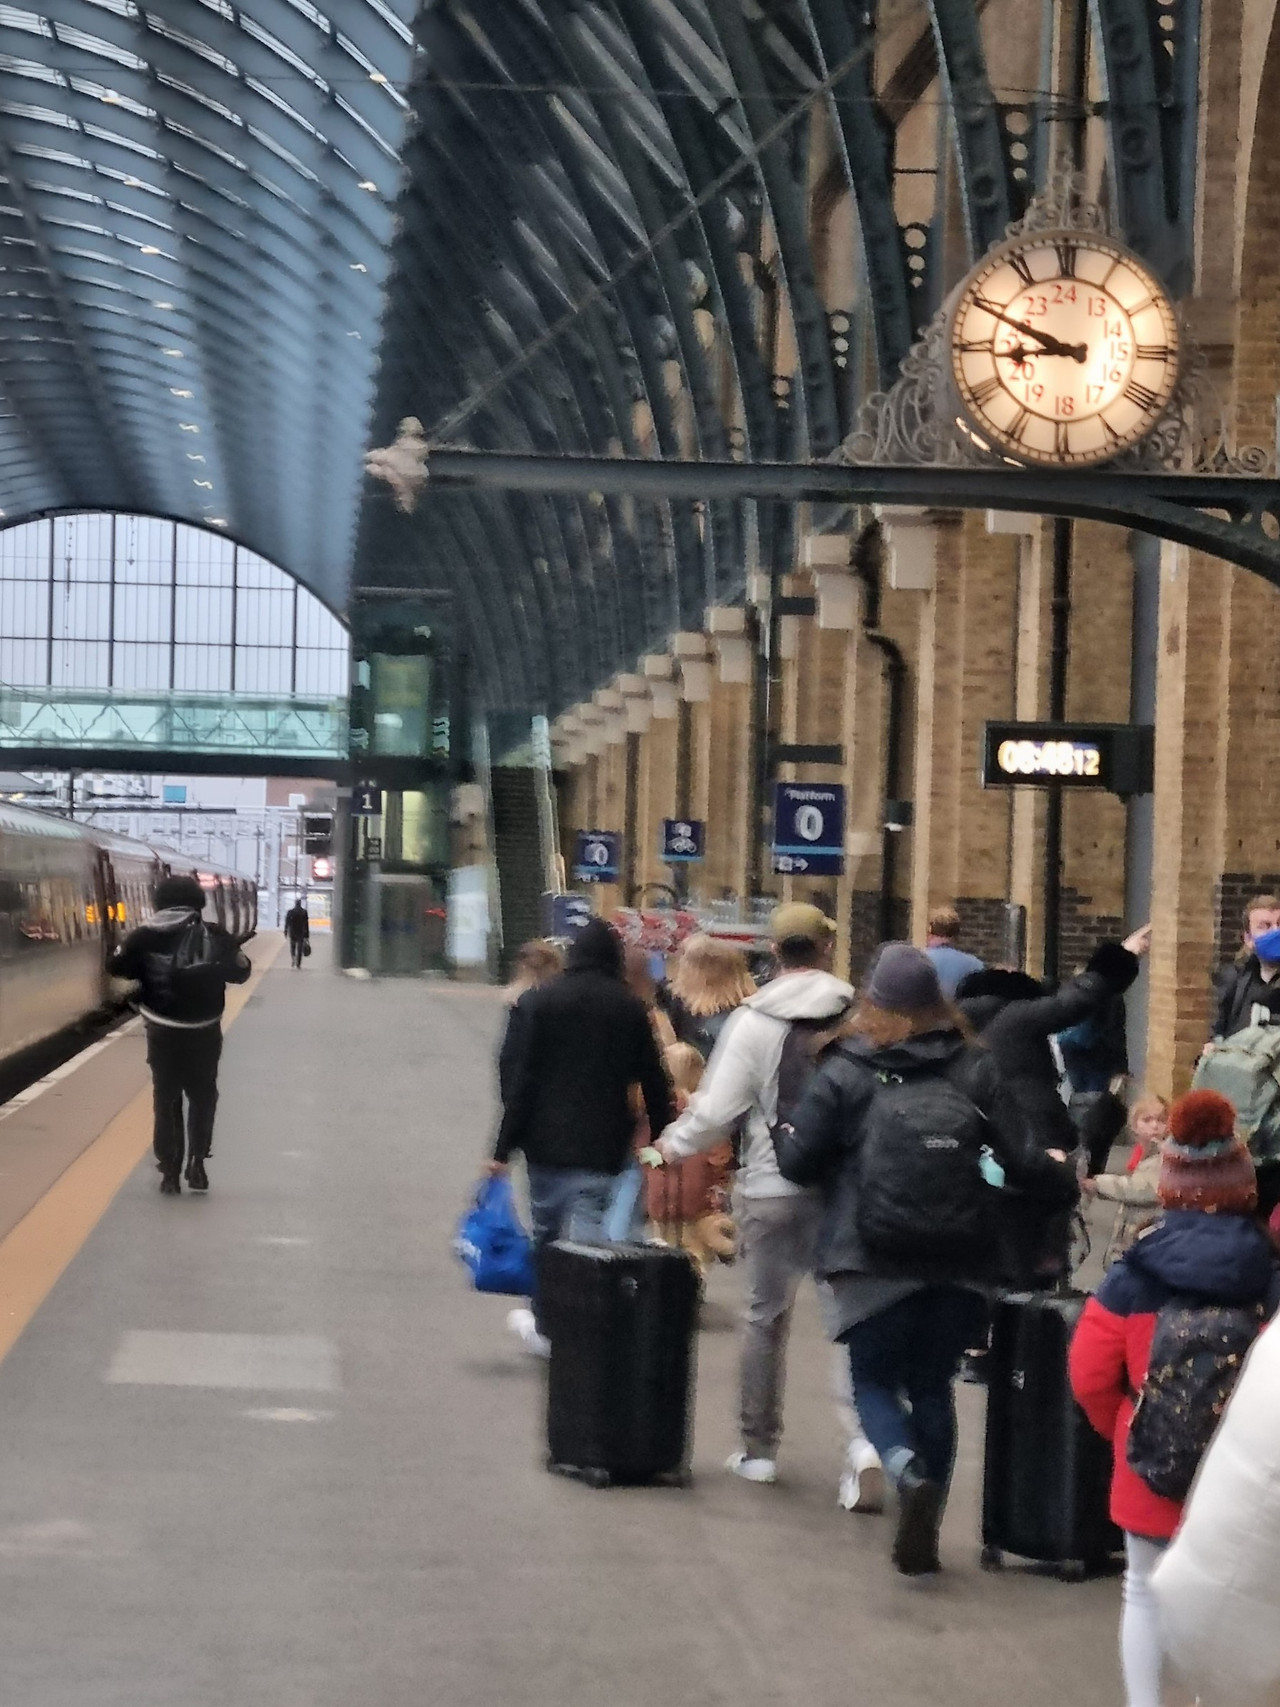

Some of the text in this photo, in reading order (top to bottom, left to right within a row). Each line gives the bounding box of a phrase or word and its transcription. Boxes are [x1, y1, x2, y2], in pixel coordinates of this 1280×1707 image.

[1051, 283, 1077, 305] 24
[1022, 295, 1048, 317] 23
[1087, 296, 1107, 317] 13
[1103, 319, 1123, 339] 14
[1110, 341, 1129, 361] 15
[1007, 360, 1036, 381] 20
[1102, 363, 1122, 382] 16
[1024, 383, 1045, 403] 19
[1085, 384, 1105, 404] 17
[1054, 395, 1075, 416] 18
[361, 793, 373, 809] 1
[795, 804, 824, 842] 0
